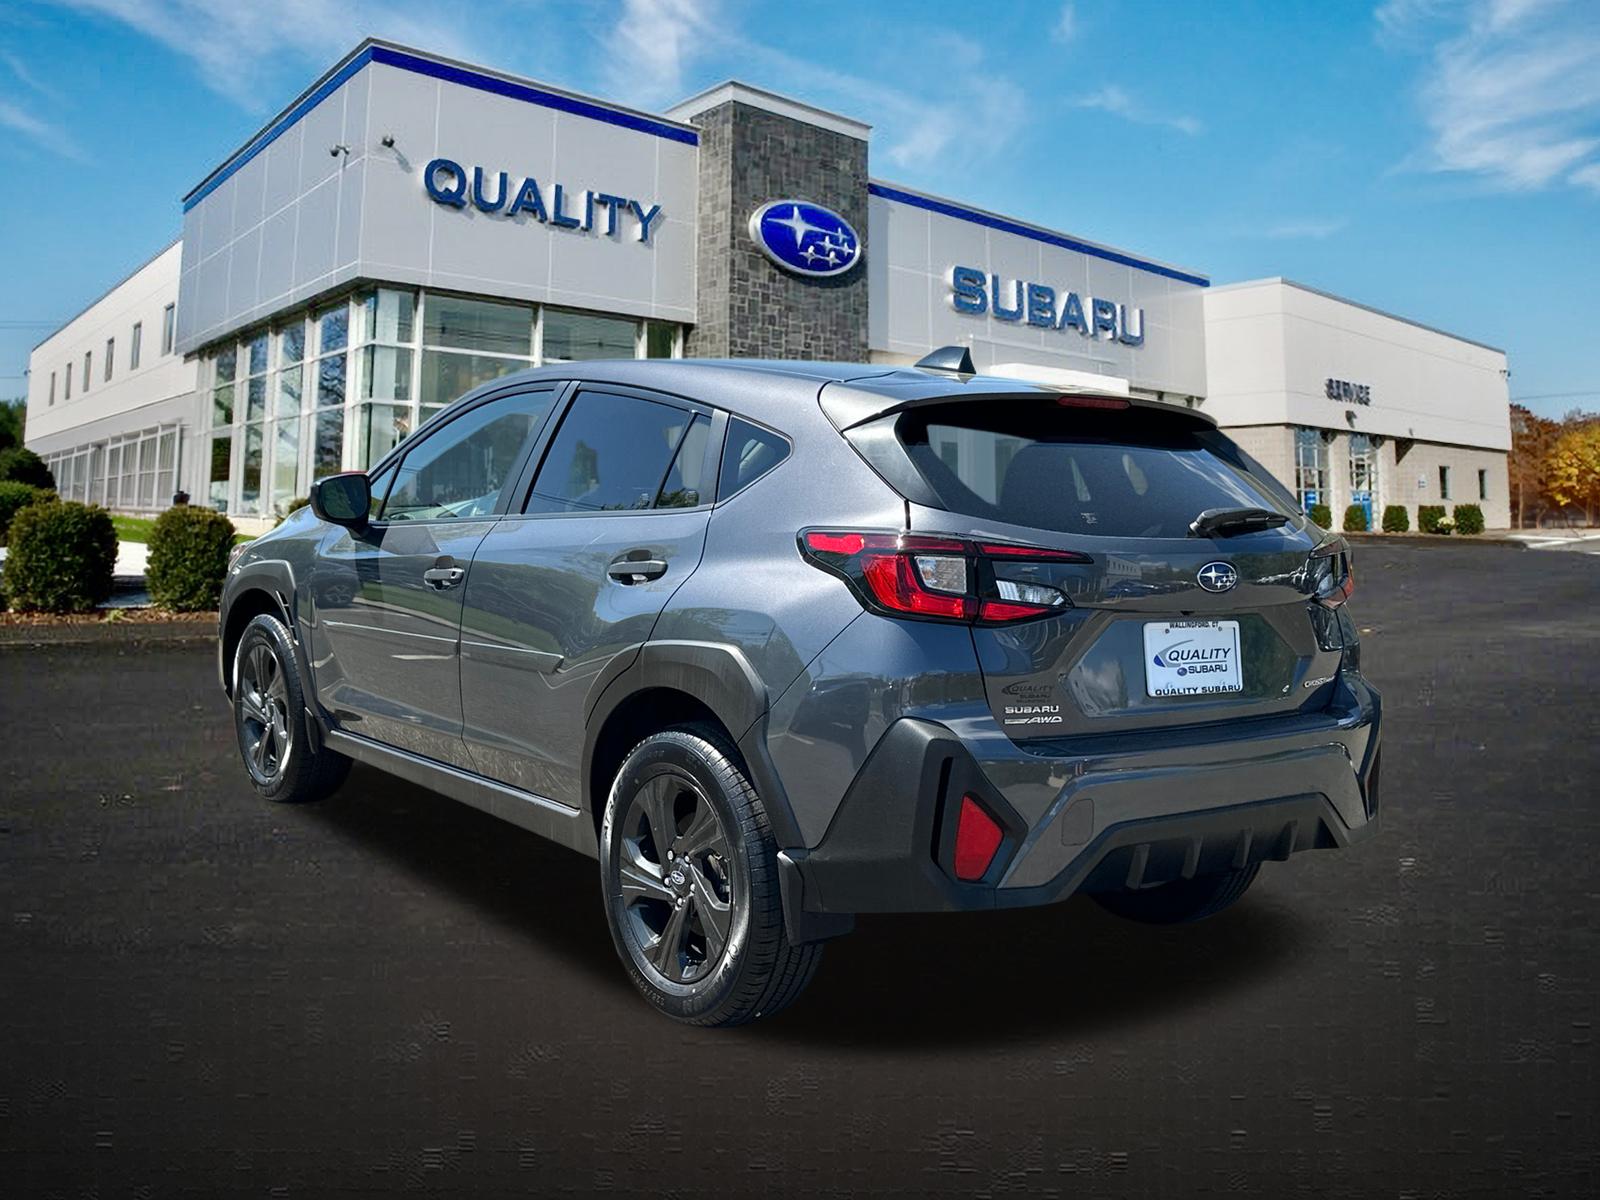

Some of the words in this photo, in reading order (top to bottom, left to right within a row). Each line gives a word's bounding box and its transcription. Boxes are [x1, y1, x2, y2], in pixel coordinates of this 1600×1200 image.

[423, 158, 662, 243] QUALITY
[951, 265, 1145, 347] SUBARU
[1168, 647, 1231, 662] QUALITY
[1188, 664, 1228, 674] SUBARU
[1011, 684, 1055, 693] QUALITY
[1155, 687, 1198, 696] QUALITY
[1201, 684, 1241, 693] SUBARU
[1004, 704, 1060, 714] SUBARU
[1027, 715, 1063, 724] AWD
